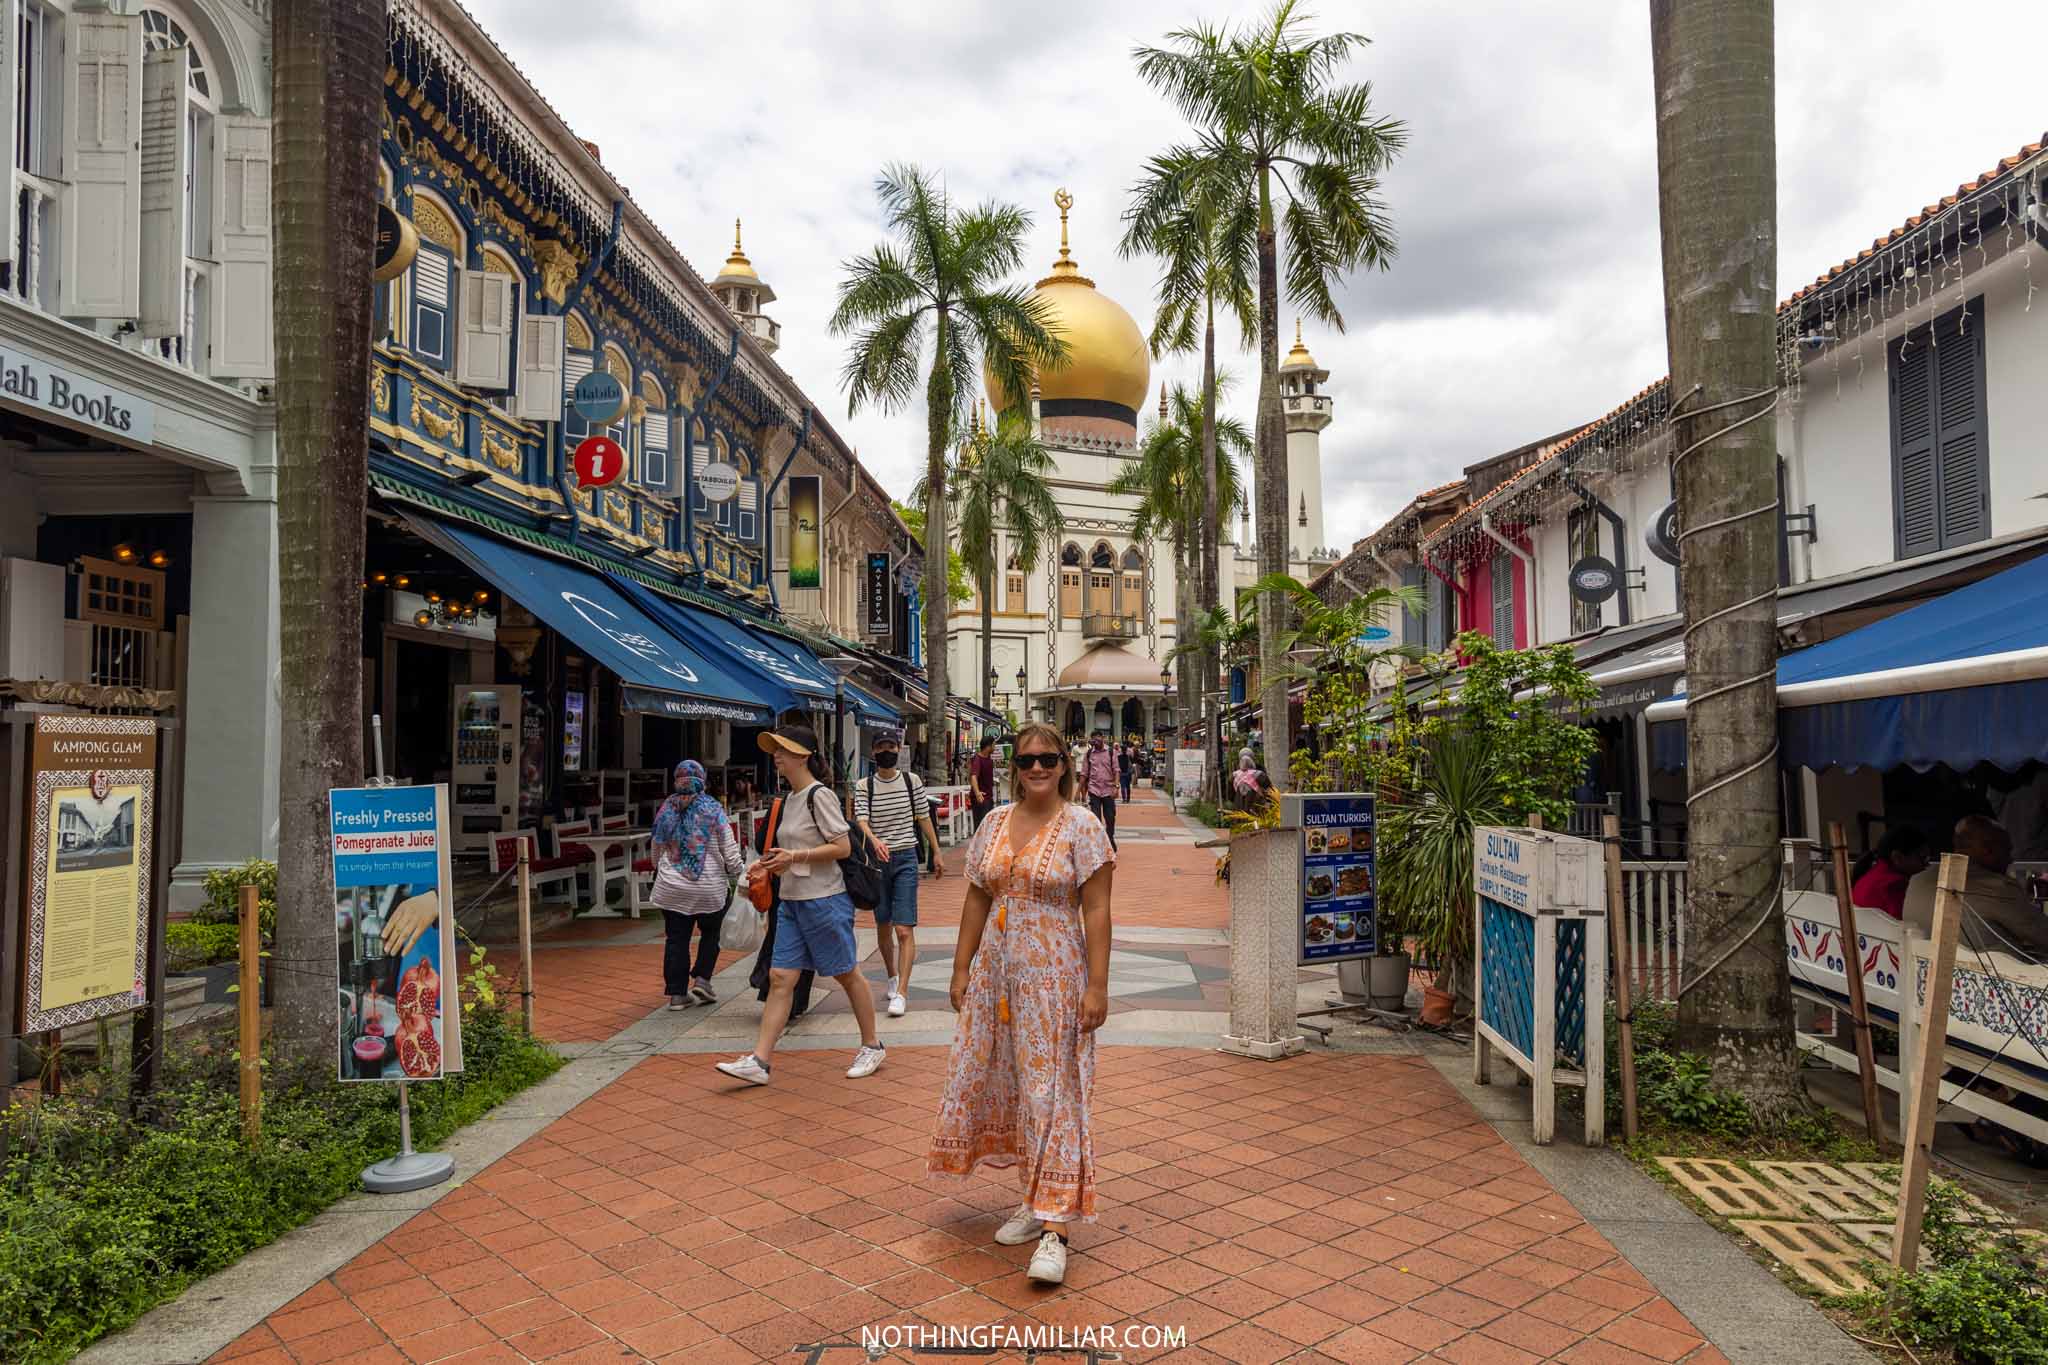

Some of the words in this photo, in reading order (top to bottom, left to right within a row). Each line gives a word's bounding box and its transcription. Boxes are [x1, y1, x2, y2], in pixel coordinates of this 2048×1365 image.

[48, 374, 131, 431] Books
[875, 567, 883, 622] AYASOFYA
[53, 741, 109, 753] KAMPONG
[112, 741, 142, 753] GLAM
[335, 809, 380, 828] Freshly
[383, 807, 433, 823] Pressed
[1306, 813, 1337, 825] SULTAN
[1338, 812, 1372, 823] TURKISH
[335, 834, 404, 852] Pomegranate
[408, 831, 434, 848] Juice
[1487, 833, 1520, 864] SULTAN
[350, 862, 373, 872] simply
[392, 860, 404, 870] the
[1501, 884, 1512, 902] THE
[1513, 888, 1528, 908] BEST
